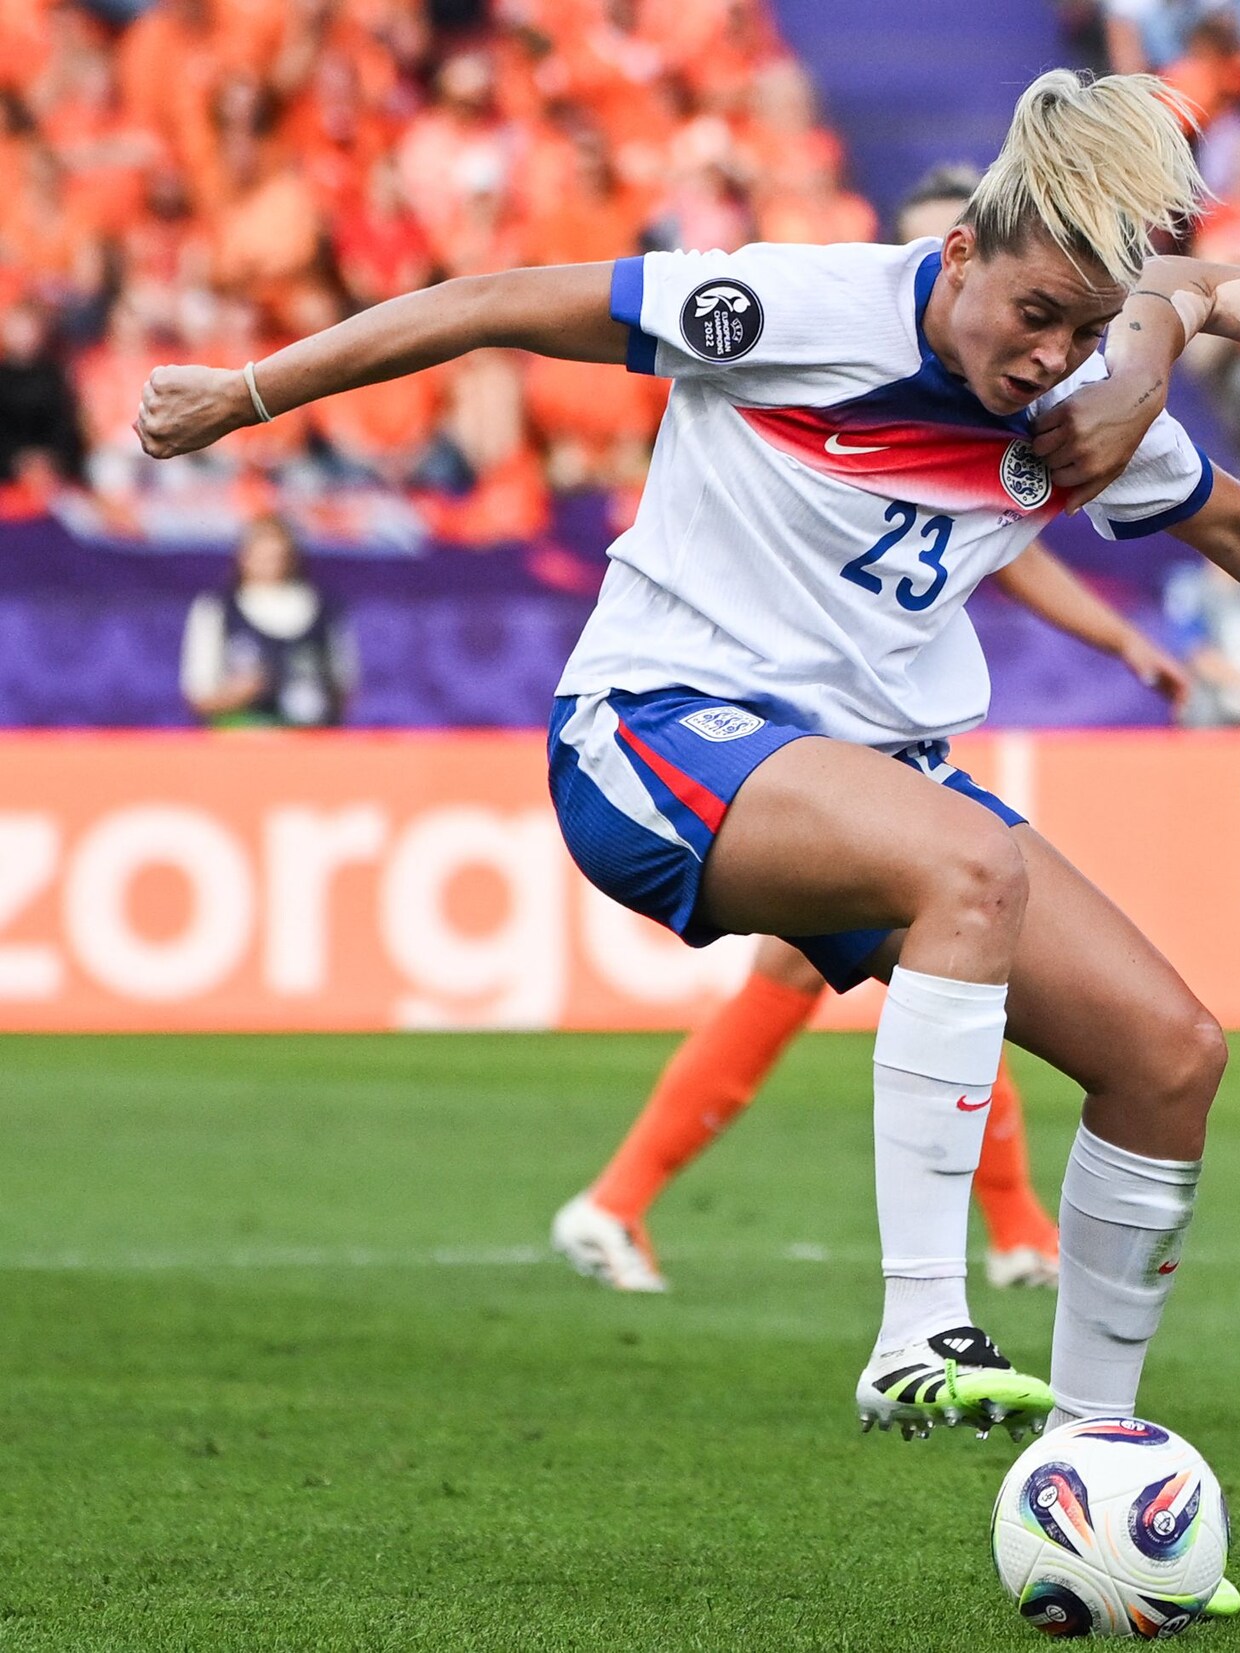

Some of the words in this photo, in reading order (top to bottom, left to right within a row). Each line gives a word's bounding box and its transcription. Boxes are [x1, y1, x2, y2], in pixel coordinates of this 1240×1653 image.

[704, 321, 714, 347] 2022
[713, 310, 724, 355] CHAMPIONS
[721, 311, 731, 352] EUROPEAN
[839, 499, 956, 612] 23
